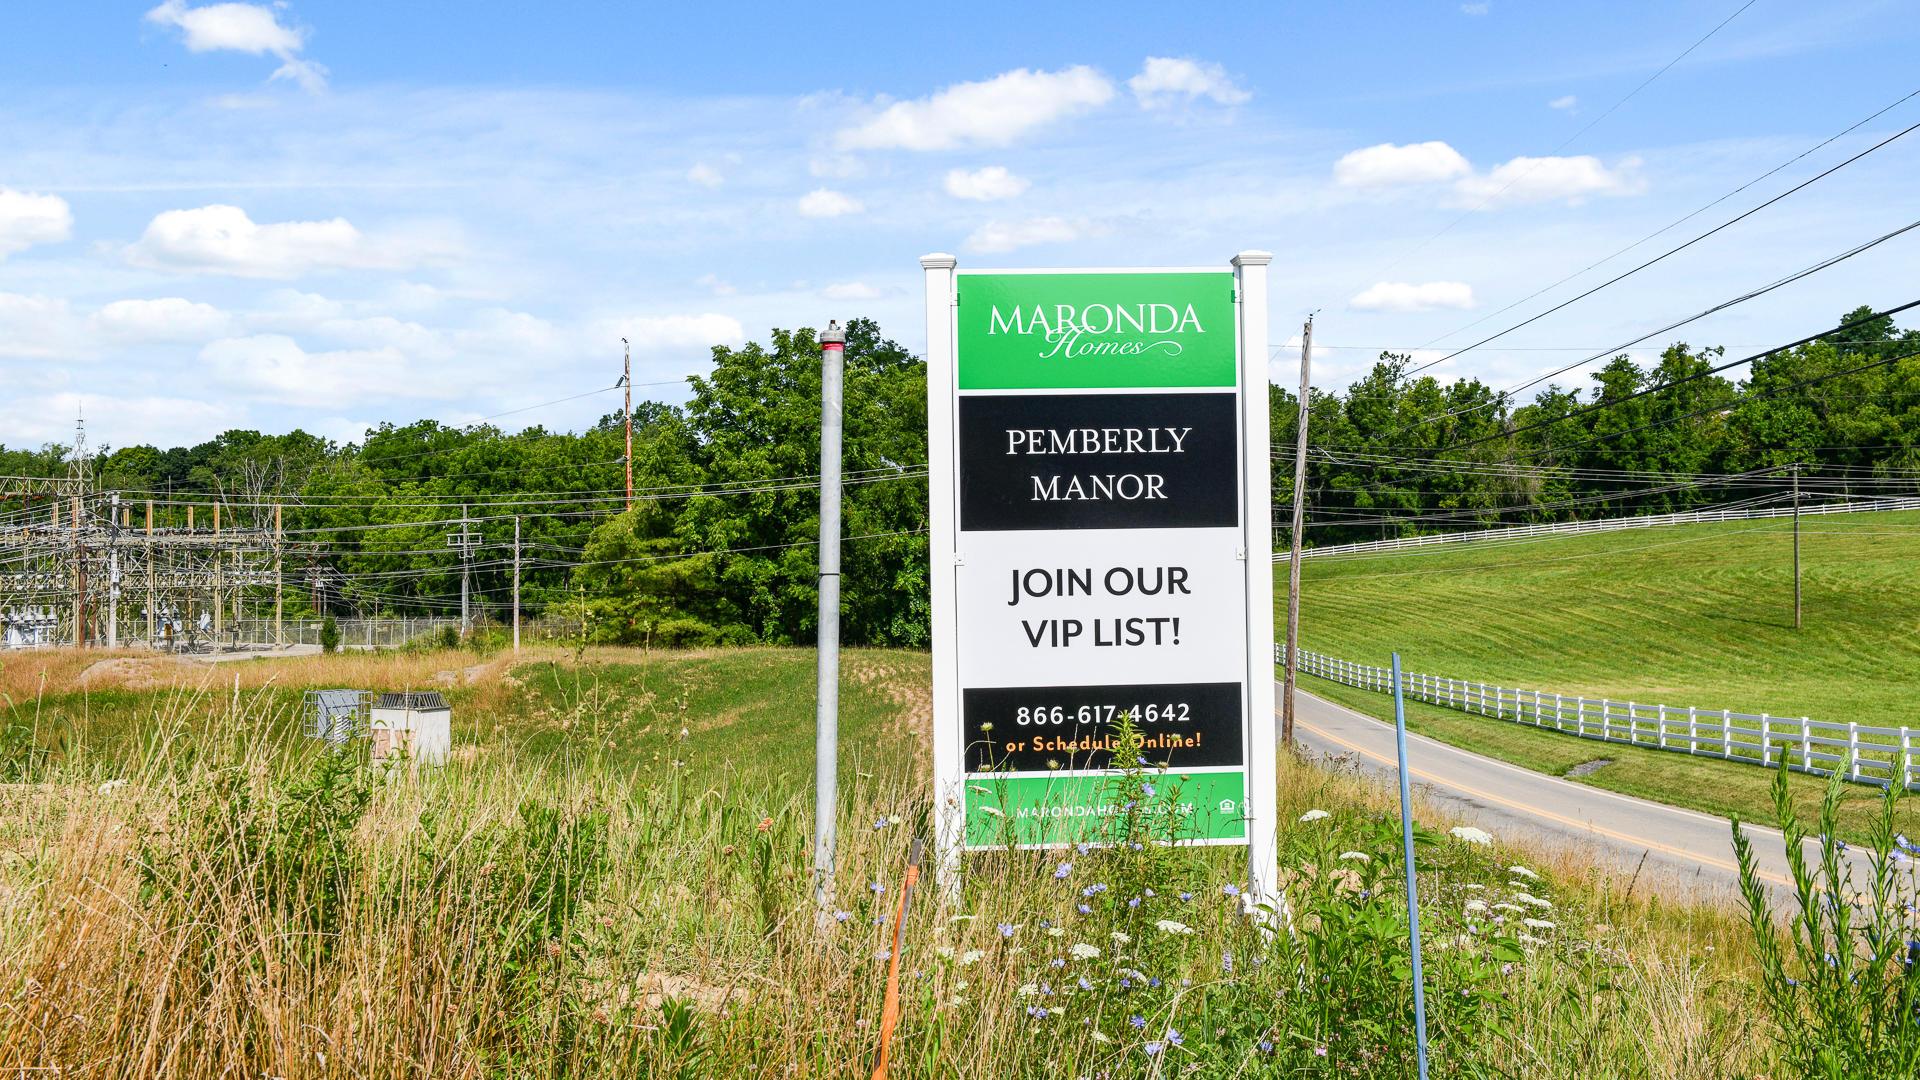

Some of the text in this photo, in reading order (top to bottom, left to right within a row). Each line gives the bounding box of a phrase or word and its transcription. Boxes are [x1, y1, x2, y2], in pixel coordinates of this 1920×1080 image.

[987, 303, 1206, 335] MARONDA
[1038, 325, 1183, 358] Homes
[1005, 427, 1193, 455] PEMBERLY
[1030, 474, 1168, 501] MANOR
[1007, 566, 1191, 607] JOIN OUR
[1021, 617, 1180, 648] VIP LIST!
[1016, 703, 1190, 726] 866-617-4642
[1005, 741, 1026, 752] or
[1033, 734, 1121, 751] Schedule
